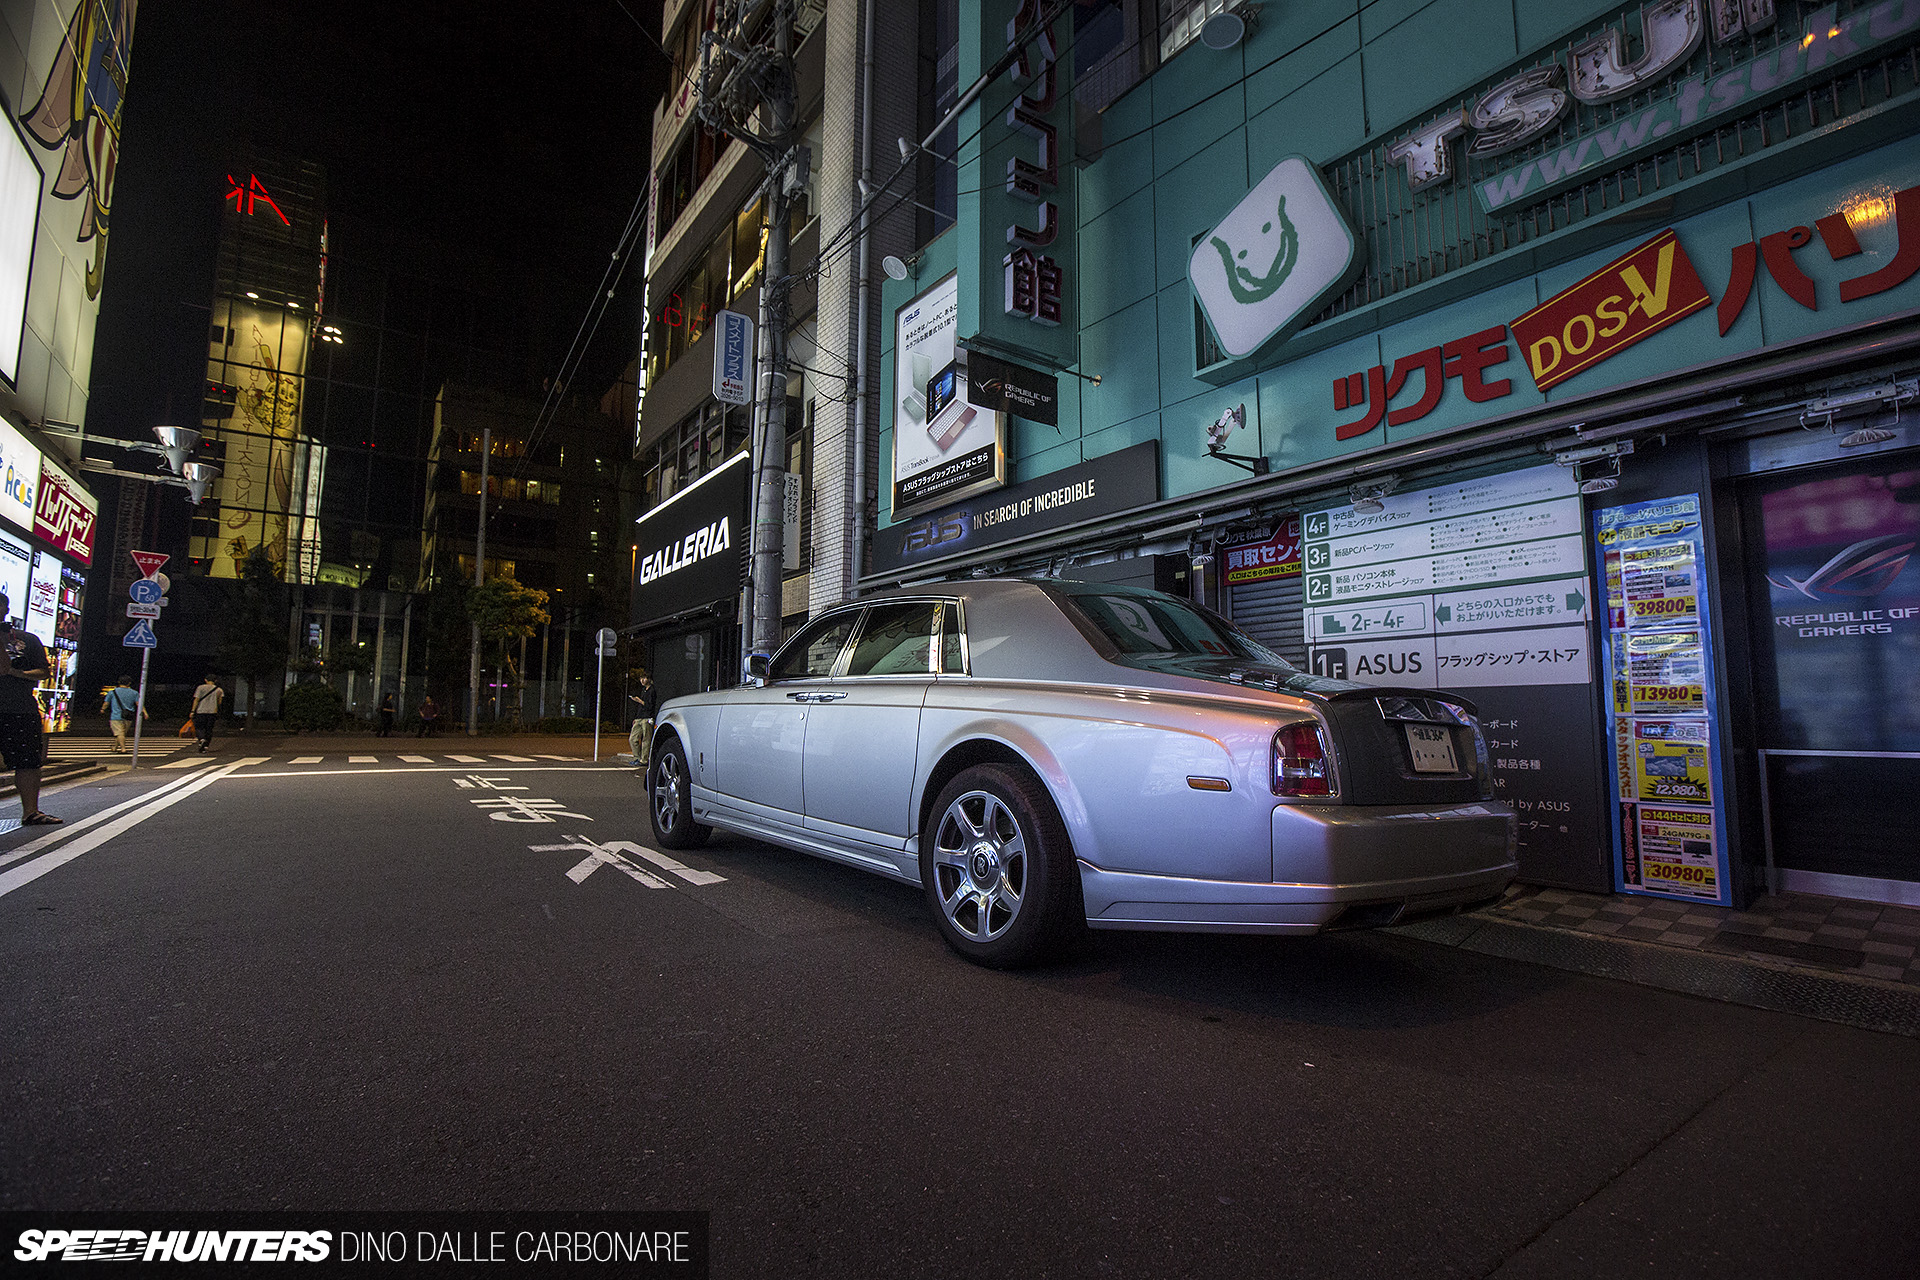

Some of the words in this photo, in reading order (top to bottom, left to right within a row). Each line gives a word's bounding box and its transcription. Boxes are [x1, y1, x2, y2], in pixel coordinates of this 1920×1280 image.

[1387, 0, 1777, 195] TSU
[903, 308, 920, 325] ASUS
[1333, 323, 1512, 441] ツクモ
[1004, 383, 1040, 401] REPUBLIC
[1041, 394, 1051, 402] OF
[1005, 391, 1035, 407] GAMERS
[903, 452, 989, 493] ASUSフラッグシップストアはこちら
[973, 515, 983, 530] IN
[984, 502, 1018, 527] SEARCH
[1020, 497, 1033, 517] OF
[1034, 478, 1096, 513] INCREDIBLE
[1308, 517, 1326, 534] 4F
[1332, 511, 1355, 521] 中古品
[897, 511, 967, 555] ASUS
[1619, 520, 1698, 542] 液晶モニター
[640, 515, 730, 586] GALLERIA
[1309, 547, 1328, 566] 3F
[139, 556, 162, 565] 止まれ
[1335, 575, 1350, 584] 新品
[1352, 569, 1396, 582] パソコン本体
[1311, 578, 1329, 597] 2F
[1456, 592, 1556, 613] どちらの入口からでも
[1351, 609, 1405, 632] 2F-4F
[1456, 605, 1562, 624] お上がりいただけます。
[1775, 608, 1884, 628] REPUBLIC
[1888, 607, 1920, 620] OF
[1798, 622, 1893, 638] GAMERS
[1317, 653, 1343, 679] 1F
[1355, 651, 1423, 676] ASUS
[1437, 648, 1580, 669] フラッグシップ・ストア
[1518, 800, 1533, 812] by
[1537, 800, 1571, 812] ASUS
[1652, 810, 1710, 824] 144Hzに対応
[1661, 830, 1711, 840] 24GM79G-B
